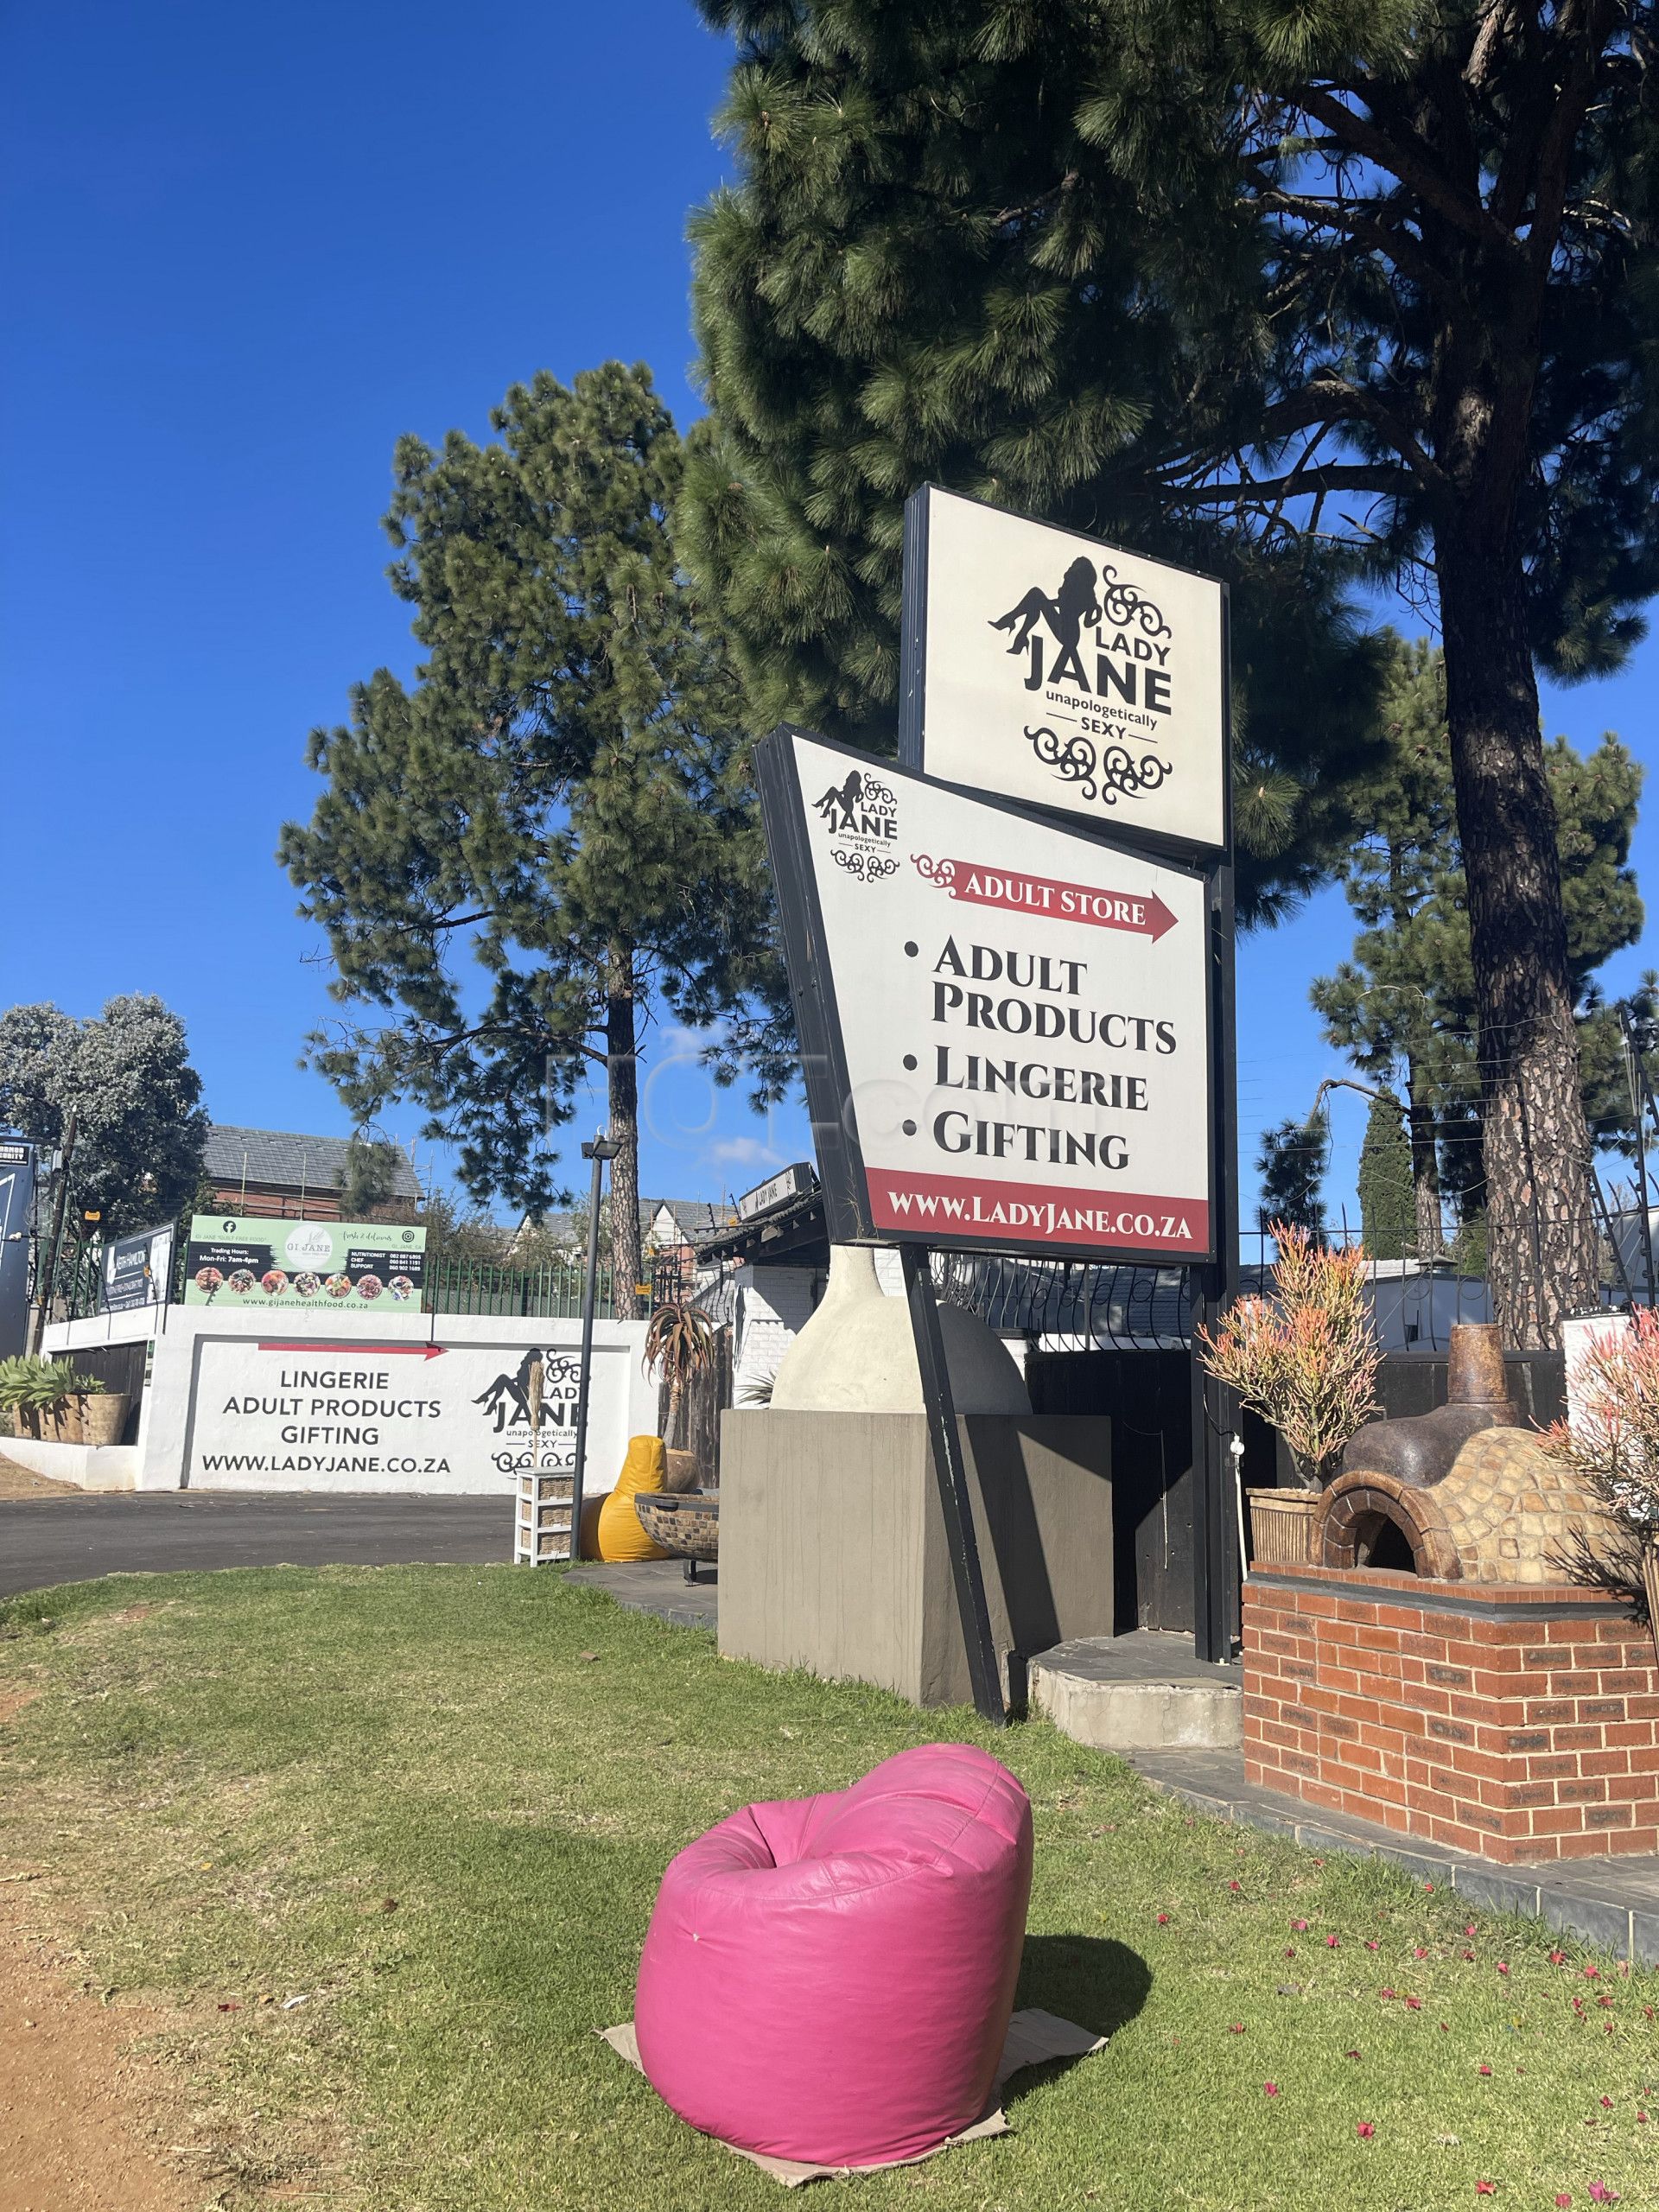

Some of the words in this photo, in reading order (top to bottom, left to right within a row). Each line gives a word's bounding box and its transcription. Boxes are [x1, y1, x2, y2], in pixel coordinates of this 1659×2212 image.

[1096, 626, 1172, 666] LADY
[1024, 634, 1172, 715] JANE
[1046, 690, 1158, 731] unapologetically
[1081, 716, 1127, 741] SEXY
[861, 801, 897, 817] LADY
[828, 808, 898, 840] JANE
[838, 832, 891, 848] unapologetically
[855, 843, 876, 853] SEXY
[964, 873, 1055, 909] ADULT
[1060, 890, 1146, 925] STORE
[931, 934, 1087, 996] ADULT
[931, 981, 1177, 1055] PRODUCTS
[933, 1045, 1149, 1111] LINGERIE
[933, 1110, 1129, 1170] GIFTING
[302, 1243, 331, 1252] JANE
[227, 1255, 259, 1265] 7am-4pm
[243, 1298, 368, 1309] www.gijanehealthfood.co.za
[280, 1370, 389, 1389] LINGERIE
[222, 1396, 303, 1415] ADULT
[311, 1399, 442, 1418] PRODUCTS
[281, 1426, 378, 1446] GIFTING
[506, 1429, 577, 1439] unapoogetically
[202, 1455, 451, 1473] WWW.LADYJANE.CO.ZA
